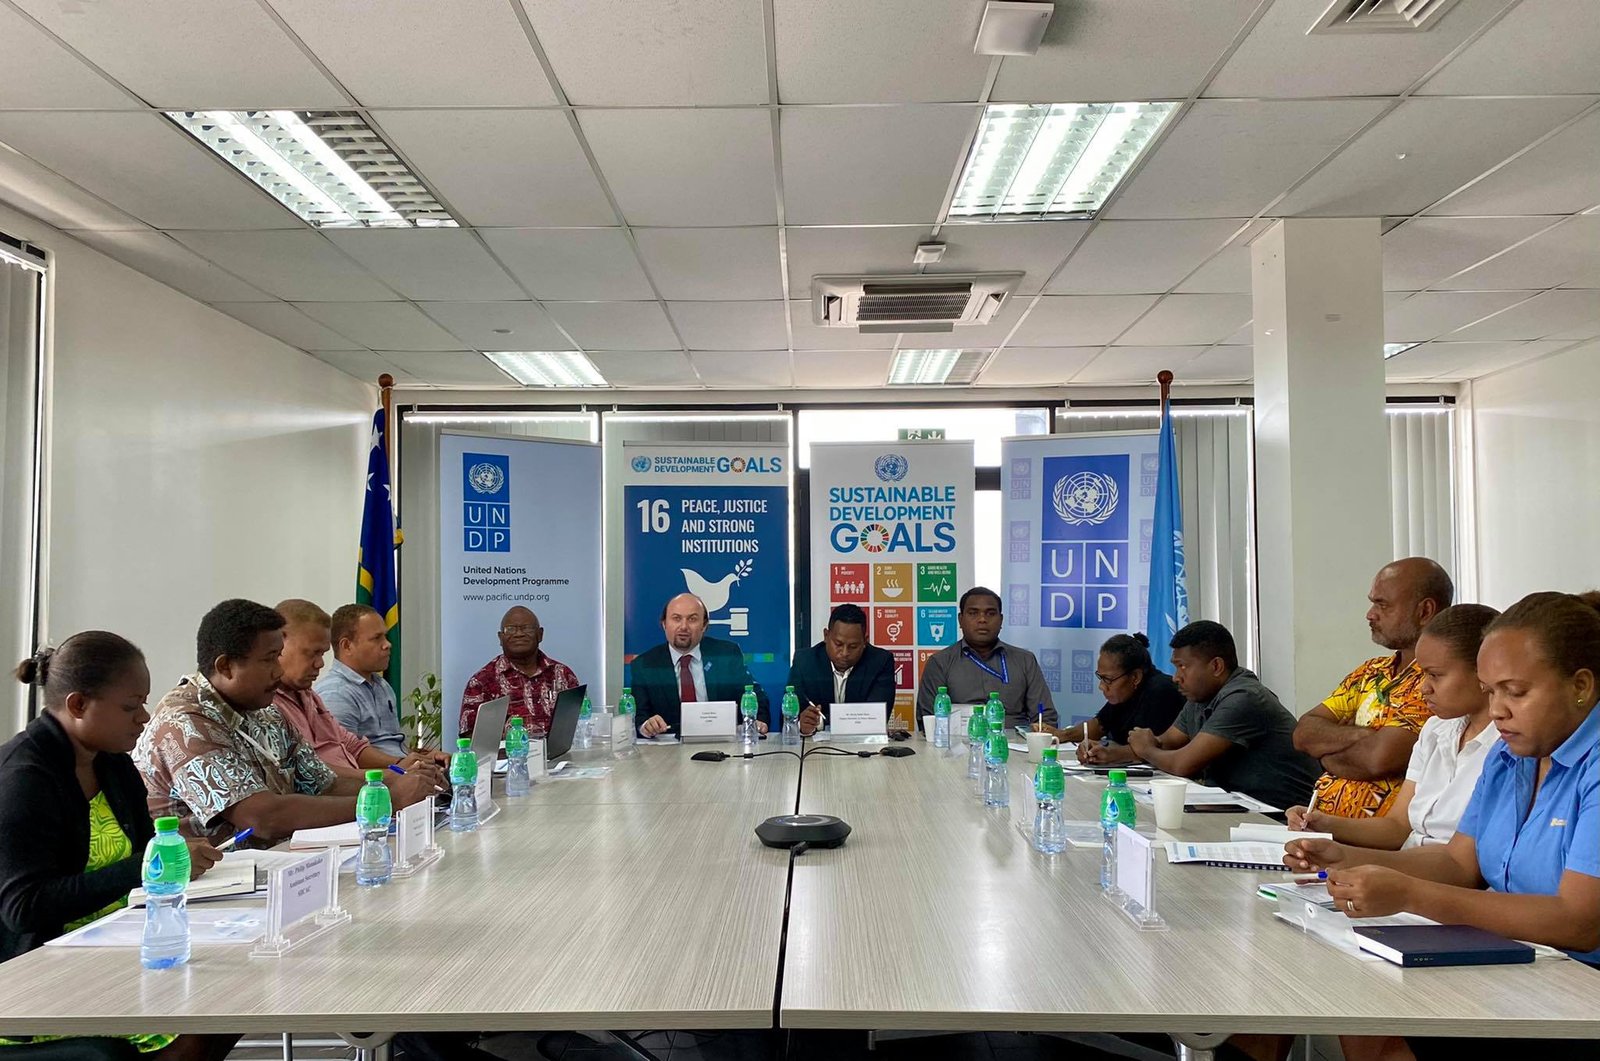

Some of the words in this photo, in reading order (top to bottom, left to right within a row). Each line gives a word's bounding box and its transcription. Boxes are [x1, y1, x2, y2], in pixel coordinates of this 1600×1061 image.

[717, 457, 782, 473] GOALS
[829, 486, 956, 503] SUSTAINABLE
[681, 499, 720, 515] PEACE,
[723, 499, 768, 513] JUSTICE
[637, 499, 671, 533] 16
[830, 505, 955, 520] DEVELOPMENT
[681, 519, 706, 533] AND
[709, 519, 755, 533] STRONG
[830, 522, 956, 553] GOALS
[681, 539, 759, 553] INSTITUTIONS
[463, 566, 492, 574] United
[494, 567, 526, 575] Nations
[834, 566, 838, 575] 1
[876, 566, 882, 575] 2
[920, 565, 926, 575] 3
[463, 577, 520, 587] Development
[522, 577, 569, 587] Programme
[463, 593, 550, 602] www.pacific.undp.org
[877, 609, 882, 618] 5
[921, 609, 926, 618] 6
[920, 652, 926, 662] 9
